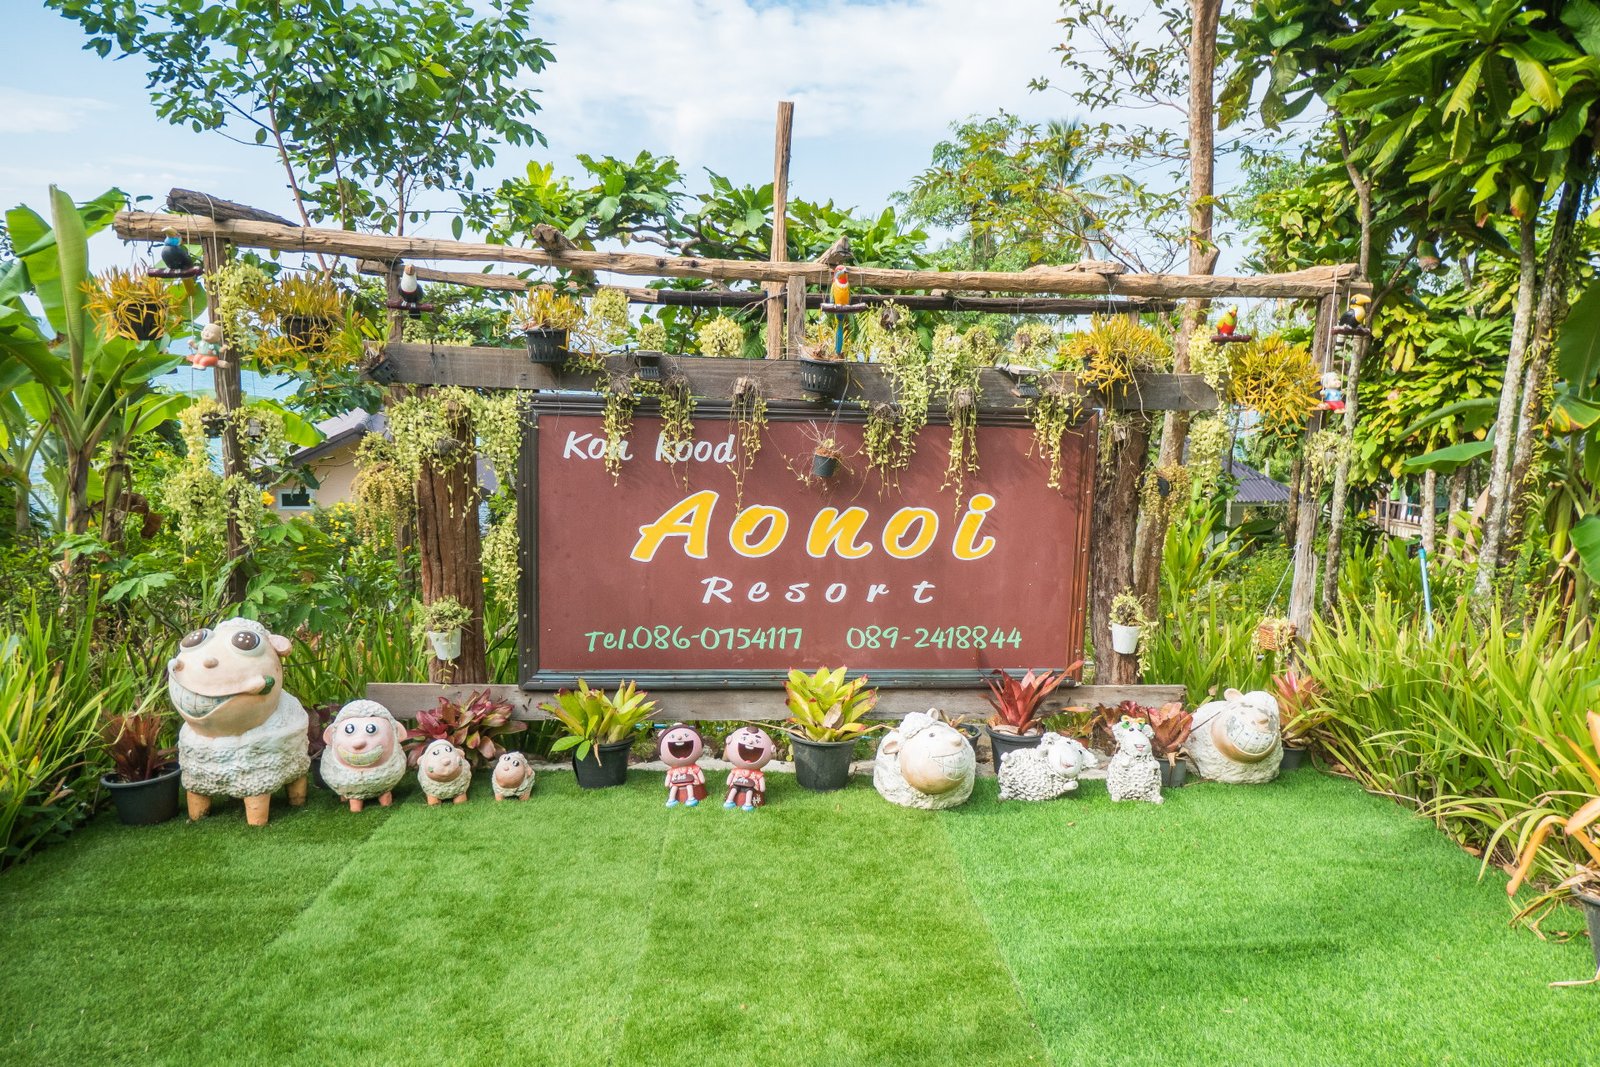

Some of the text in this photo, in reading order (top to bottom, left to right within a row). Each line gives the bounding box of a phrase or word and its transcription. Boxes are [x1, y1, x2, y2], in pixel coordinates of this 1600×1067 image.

[629, 489, 997, 563] Aonoi
[700, 575, 937, 605] Resort
[584, 624, 1022, 652] Tel.086-0754117 089-2418844
